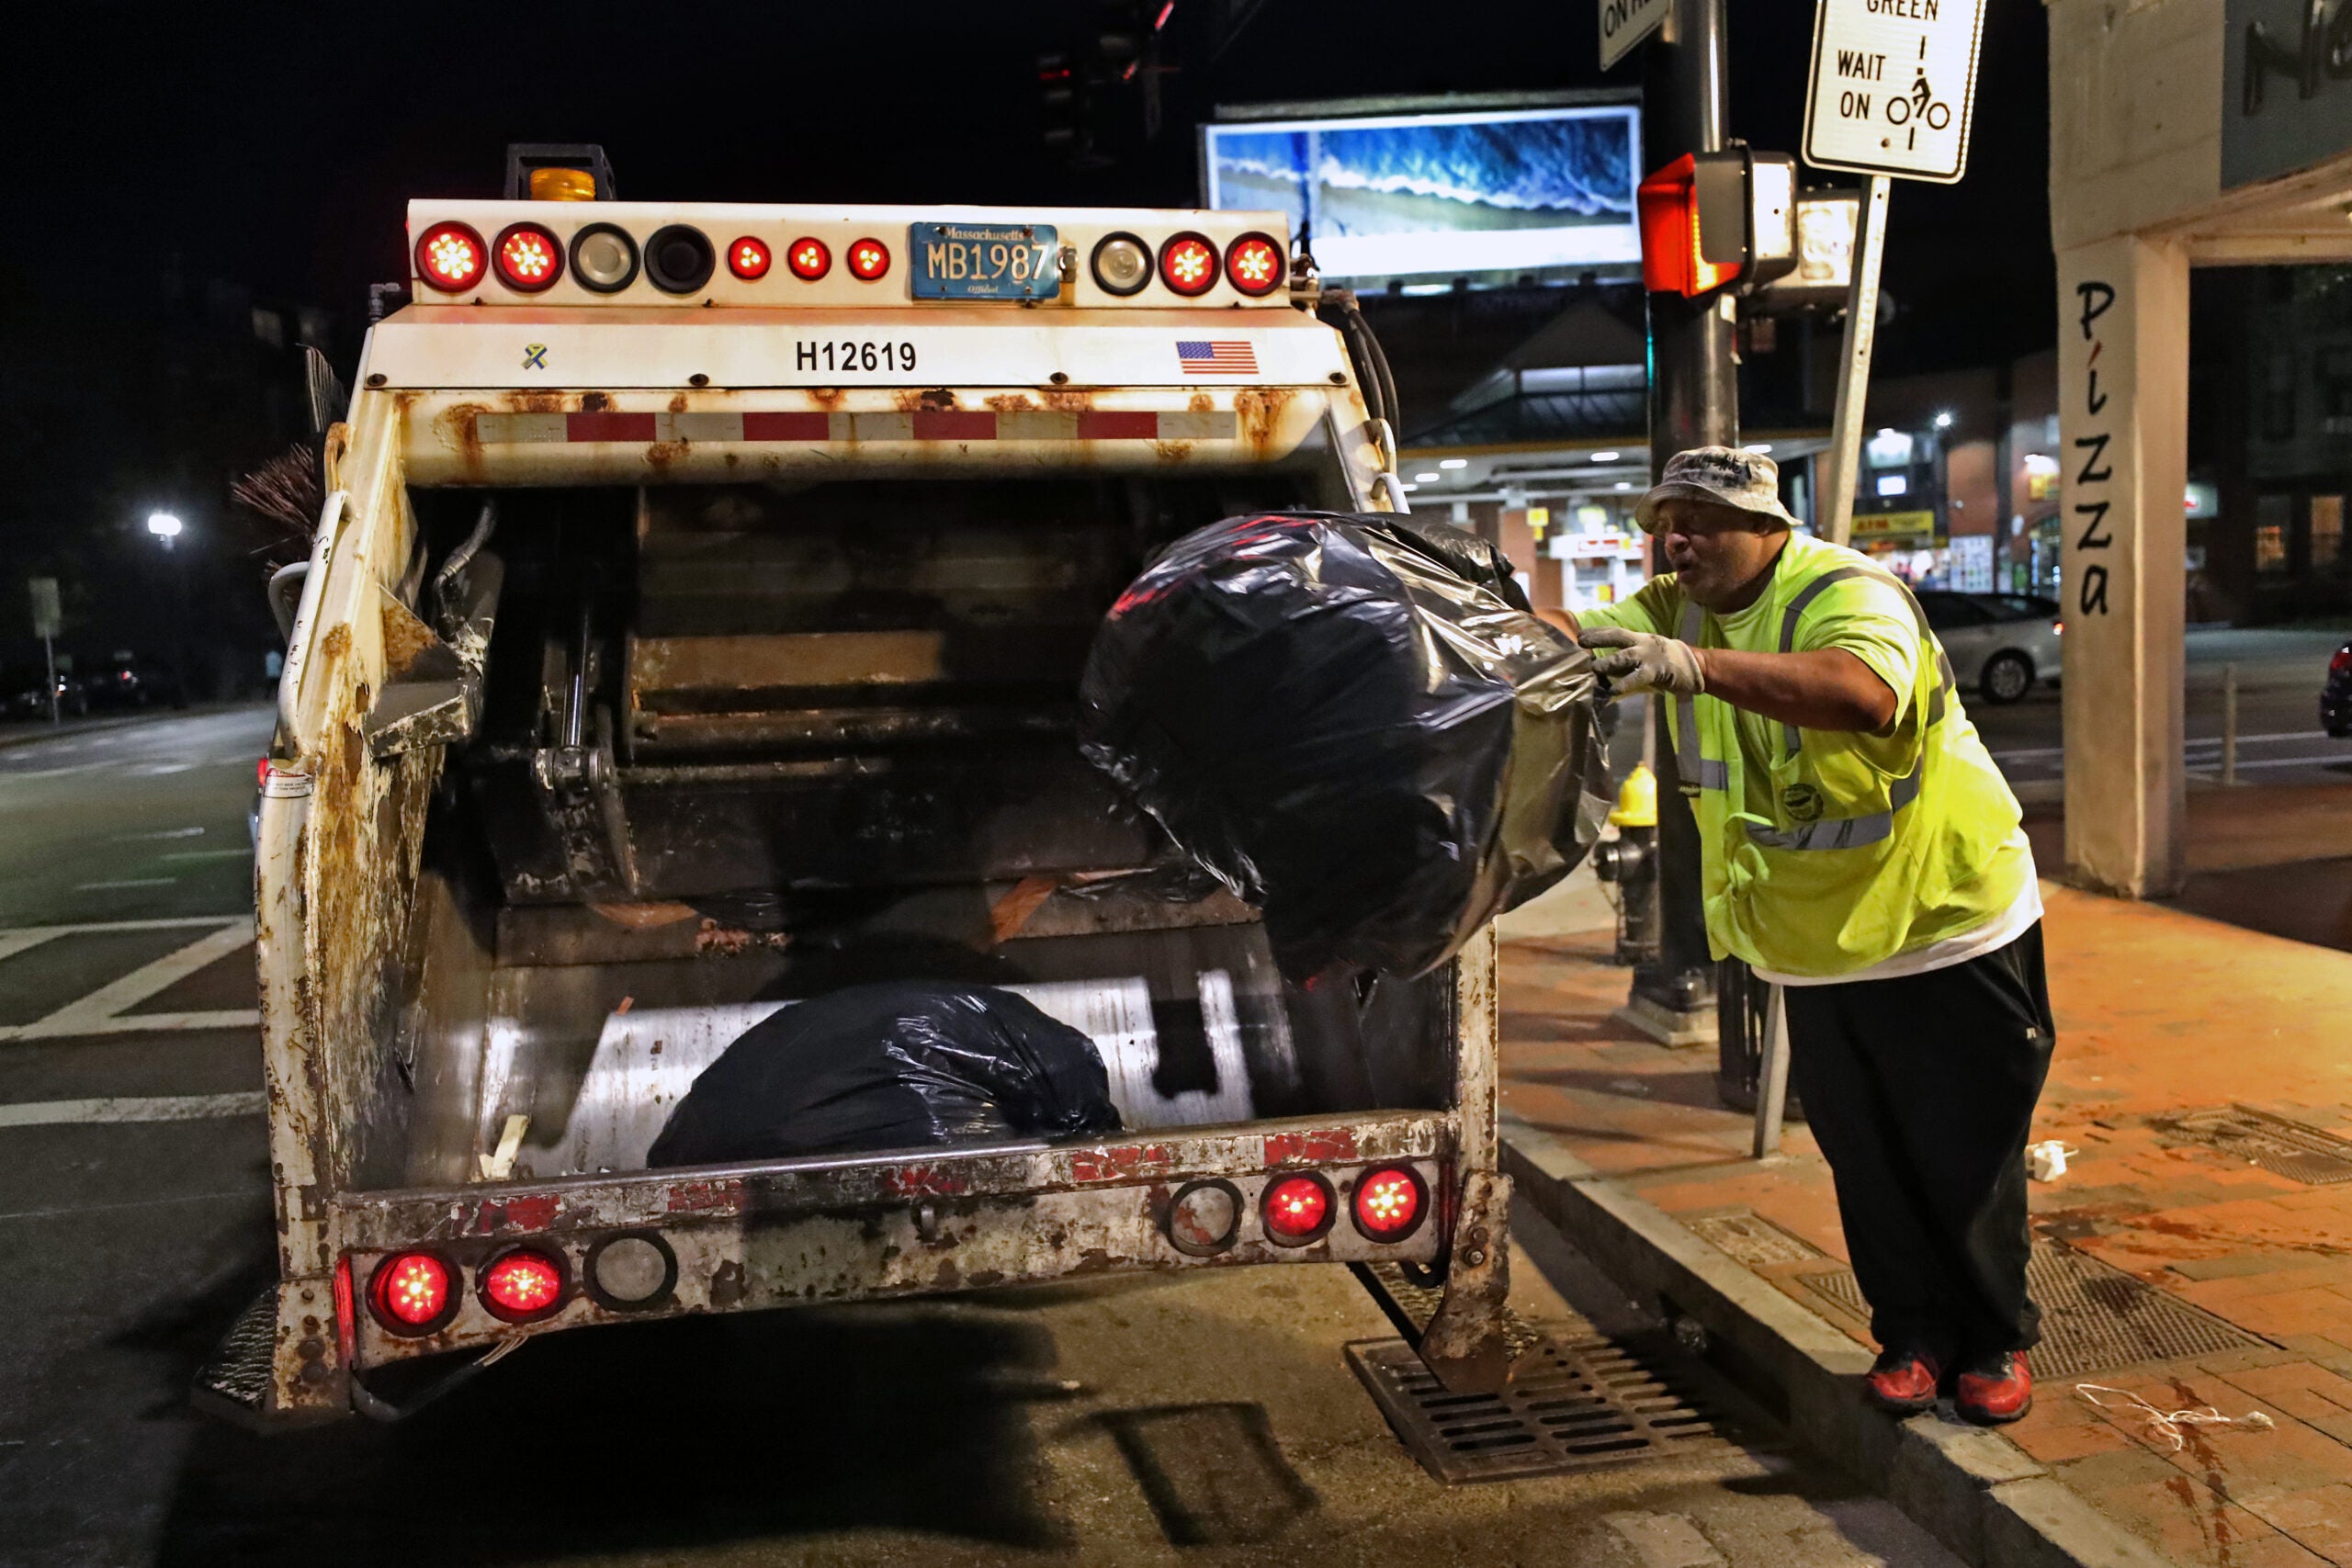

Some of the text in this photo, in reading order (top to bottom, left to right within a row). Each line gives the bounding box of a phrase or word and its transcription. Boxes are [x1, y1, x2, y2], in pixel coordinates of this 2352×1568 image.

[1604, 0, 1627, 38] ON
[1867, 0, 1939, 21] GREEN
[1838, 50, 1886, 81] WAIT
[1840, 91, 1871, 119] ON
[945, 227, 1024, 241] Massachusetts
[927, 243, 1049, 280] MB1987
[797, 341, 917, 371] H12619
